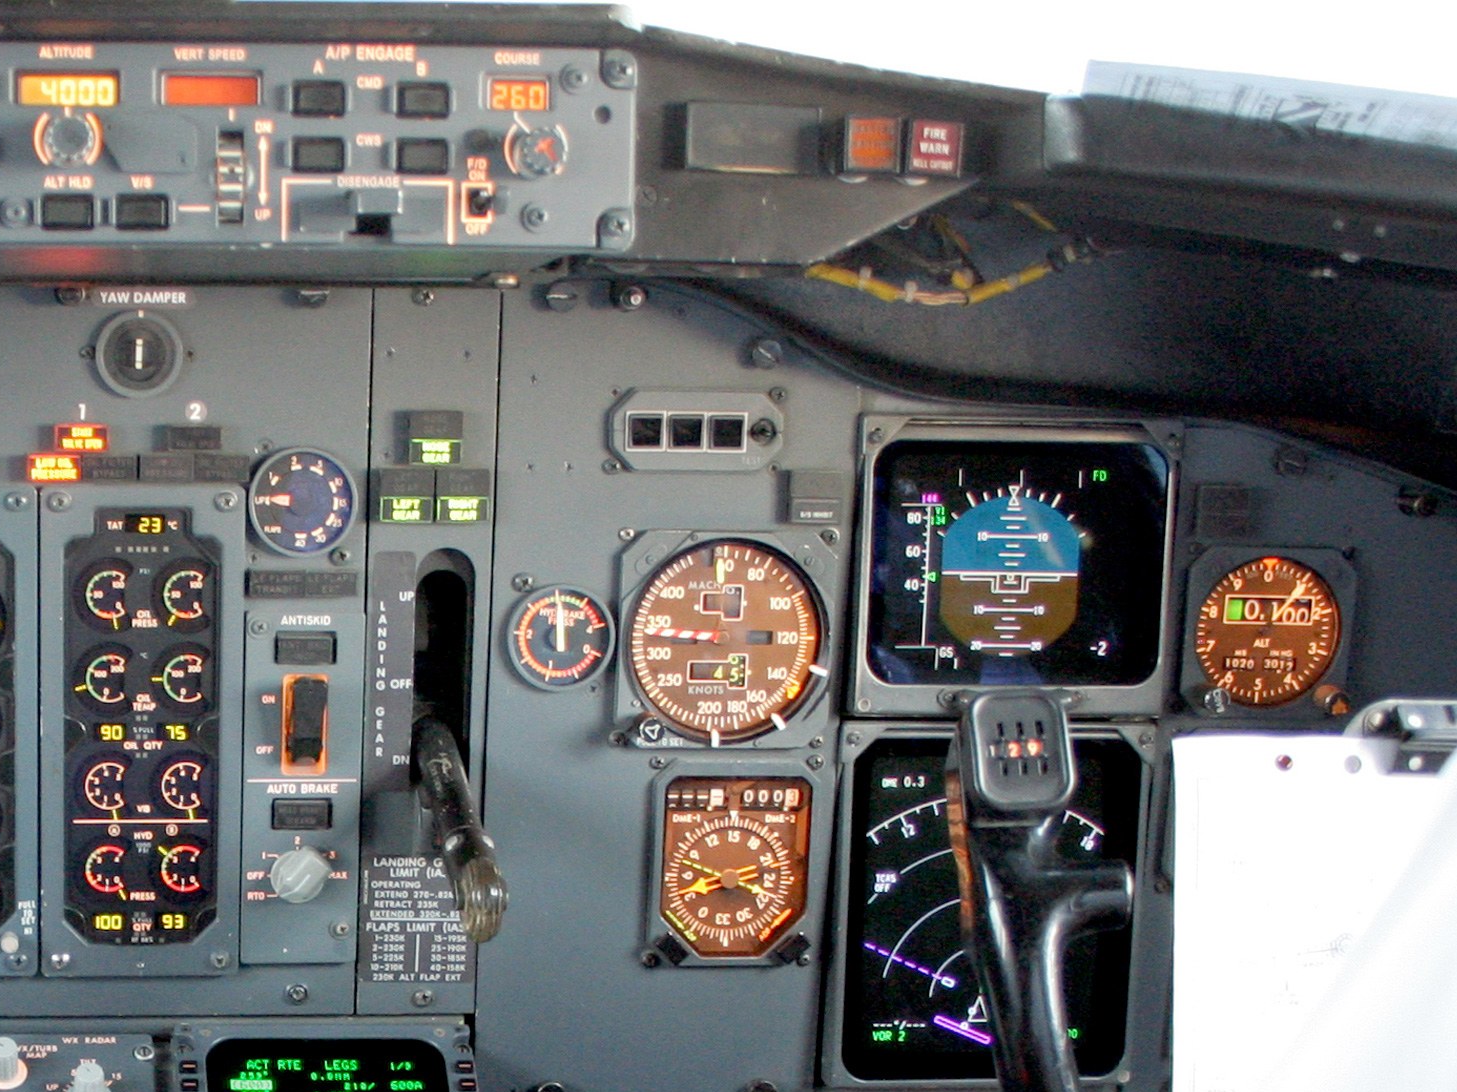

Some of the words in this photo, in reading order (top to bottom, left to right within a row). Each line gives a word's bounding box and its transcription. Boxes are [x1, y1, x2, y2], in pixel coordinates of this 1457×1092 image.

[39, 47, 93, 60] ALTITUDE
[174, 49, 204, 61] VERT
[208, 49, 246, 61] SPEED
[326, 45, 350, 60] A/P
[356, 45, 416, 62] ENGAGE
[495, 53, 540, 66] COURSE
[313, 62, 324, 75] A
[416, 63, 426, 77] B
[357, 76, 383, 89] CMD
[41, 79, 115, 105] 4000
[492, 85, 544, 110] 260
[923, 127, 946, 140] FIRE
[356, 134, 382, 147] CWS
[919, 142, 950, 156] WARN
[44, 177, 65, 188] ALT
[69, 177, 91, 188] HLD
[131, 176, 152, 188] V/S
[337, 177, 400, 188] DISENGAGE
[466, 224, 489, 236] OFF
[100, 291, 131, 305] YAW
[133, 291, 186, 305] DAMPER
[78, 403, 86, 421] 1
[189, 403, 202, 421] 2
[421, 453, 451, 464] GEAR
[1092, 469, 1107, 482] FD
[392, 499, 420, 510] LEFT
[448, 498, 479, 510] RIGHT
[106, 520, 124, 531] TAT
[138, 516, 162, 533] 23
[399, 591, 415, 602] UP
[660, 586, 684, 599] 400
[770, 598, 791, 610] 100
[132, 618, 158, 628] PRESS
[280, 615, 331, 626] ANTISKID
[647, 616, 671, 628] 350
[777, 632, 798, 644] 120
[647, 648, 671, 660] 300
[390, 679, 412, 690] OFF
[658, 674, 682, 686] 250
[688, 685, 724, 695] KNOTS
[261, 695, 276, 704] ON
[132, 702, 157, 712] TEMP
[697, 702, 721, 714] 200
[100, 725, 124, 741] 90
[165, 725, 186, 741] 75
[144, 741, 164, 751] QTY
[255, 745, 273, 755] OFF
[393, 755, 410, 765] DN
[267, 784, 295, 794] AUTO
[301, 783, 338, 794] BRAKE
[672, 814, 701, 823] DME-1
[765, 814, 796, 824] DME-2
[727, 830, 741, 843] 15
[373, 857, 426, 868] LANDING
[390, 868, 420, 878] LIMIT
[370, 880, 422, 889] OPERATING
[130, 892, 156, 901] PRESS
[374, 890, 409, 899] EXTEND
[373, 901, 413, 909] RETRACT
[95, 914, 122, 930] 100
[161, 914, 184, 929] 93
[366, 922, 400, 932] FLAPS
[406, 922, 437, 932] LIMIT
[62, 1036, 79, 1044] WX
[85, 1037, 117, 1045] RADAR
[872, 1030, 893, 1041] VOR
[247, 1059, 270, 1070] ACT
[278, 1059, 302, 1070] RTE
[324, 1060, 359, 1071] LEGS
